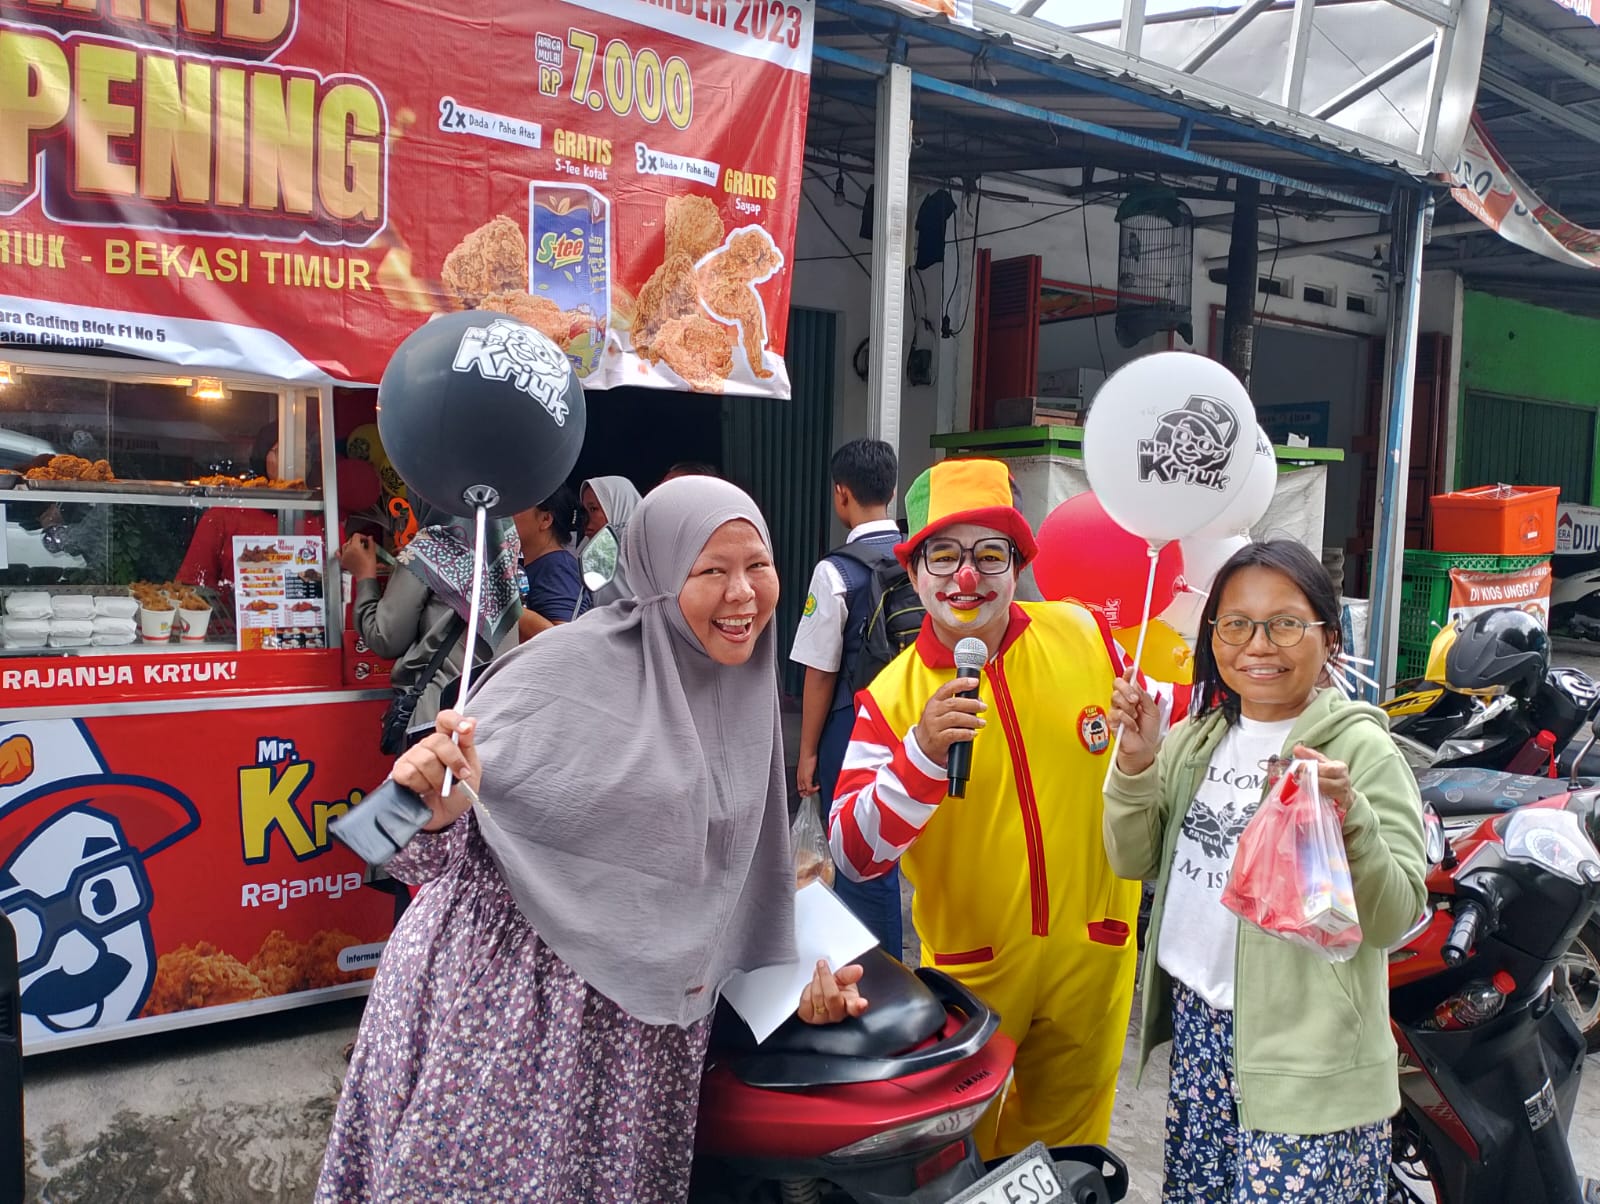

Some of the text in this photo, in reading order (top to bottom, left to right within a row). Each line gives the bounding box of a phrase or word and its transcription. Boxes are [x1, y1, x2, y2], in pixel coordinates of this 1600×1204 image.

[733, 0, 801, 49] 2023
[537, 35, 561, 51] HARGA
[537, 49, 561, 64] MULAI
[541, 68, 562, 95] RP
[569, 28, 692, 130] 7.000
[442, 100, 466, 129] 2x
[469, 117, 489, 129] Dada
[499, 123, 517, 136] Paha
[519, 126, 536, 140] Atas
[553, 128, 612, 166] GRATIS
[637, 146, 658, 172] 3x
[660, 159, 678, 170] Dada
[686, 162, 701, 175] Paha
[555, 160, 608, 181] S-Tee Kotak
[724, 168, 777, 200] GRATIS
[735, 198, 761, 216] Sayap
[105, 239, 248, 283] BEKASI
[260, 251, 372, 291] TIMUR
[25, 313, 79, 333] Gading
[83, 320, 115, 336] Blok
[118, 324, 132, 338] F1
[135, 327, 153, 341] No
[156, 329, 166, 343] 5
[456, 340, 569, 424] Kriuk
[1139, 454, 1229, 490] Kriuk
[1470, 587, 1480, 602] DI
[1481, 585, 1503, 601] KIOS
[2, 661, 237, 690] RAJANYA KRIUK!
[258, 740, 297, 763] Mr.
[1208, 766, 1264, 790] LCOM
[241, 872, 362, 910] Rajanya
[953, 1070, 993, 1094] YAMAHA
